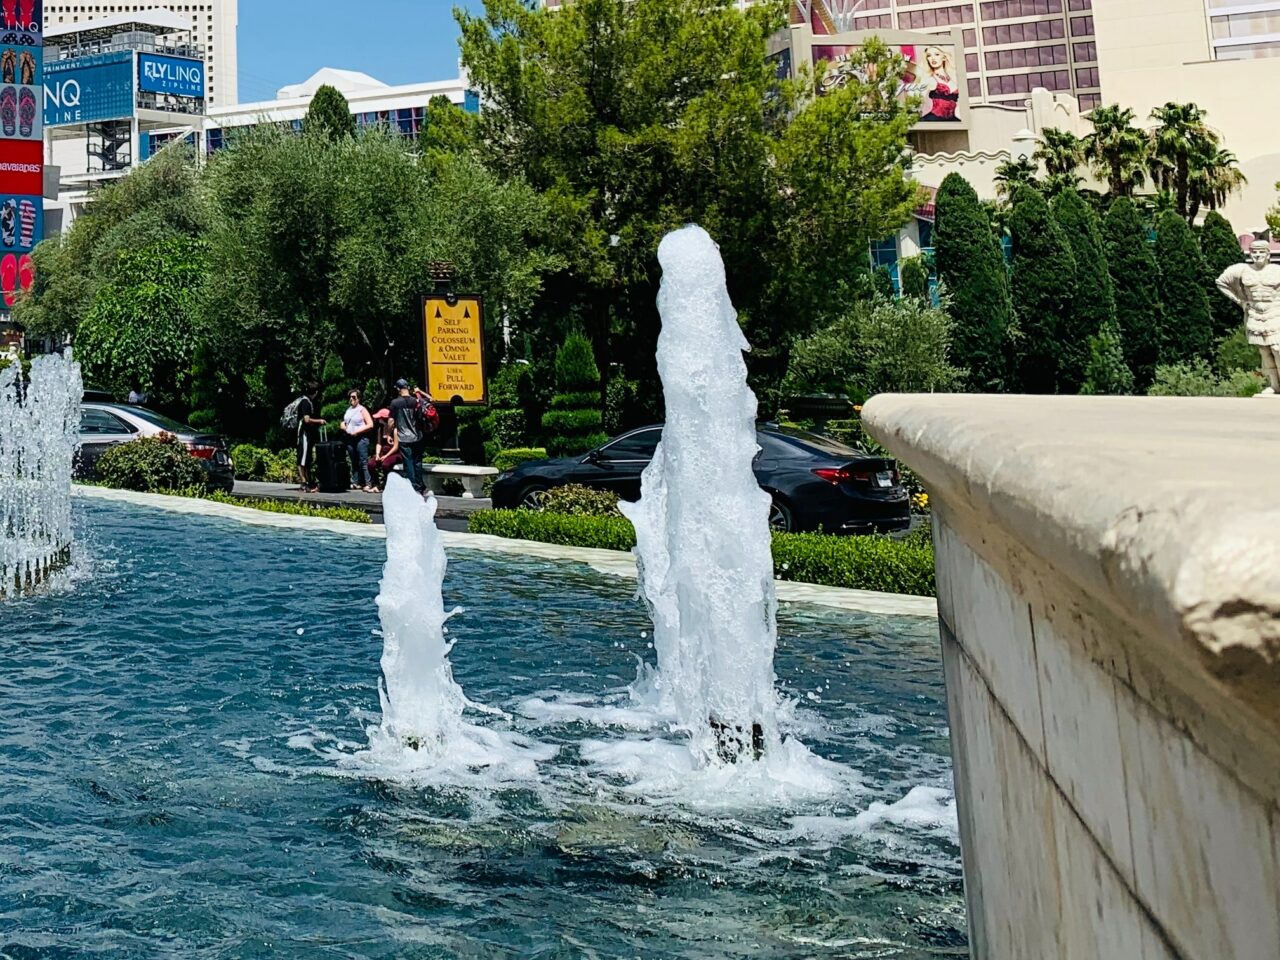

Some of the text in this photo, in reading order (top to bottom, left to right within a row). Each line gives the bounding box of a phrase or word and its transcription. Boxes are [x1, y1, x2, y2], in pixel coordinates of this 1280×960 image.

[162, 80, 201, 92] ZIPLINE
[437, 327, 469, 335] PARKING
[431, 336, 475, 344] COLOSSEUM
[445, 344, 470, 352] OMNIA
[446, 374, 465, 382] PULL
